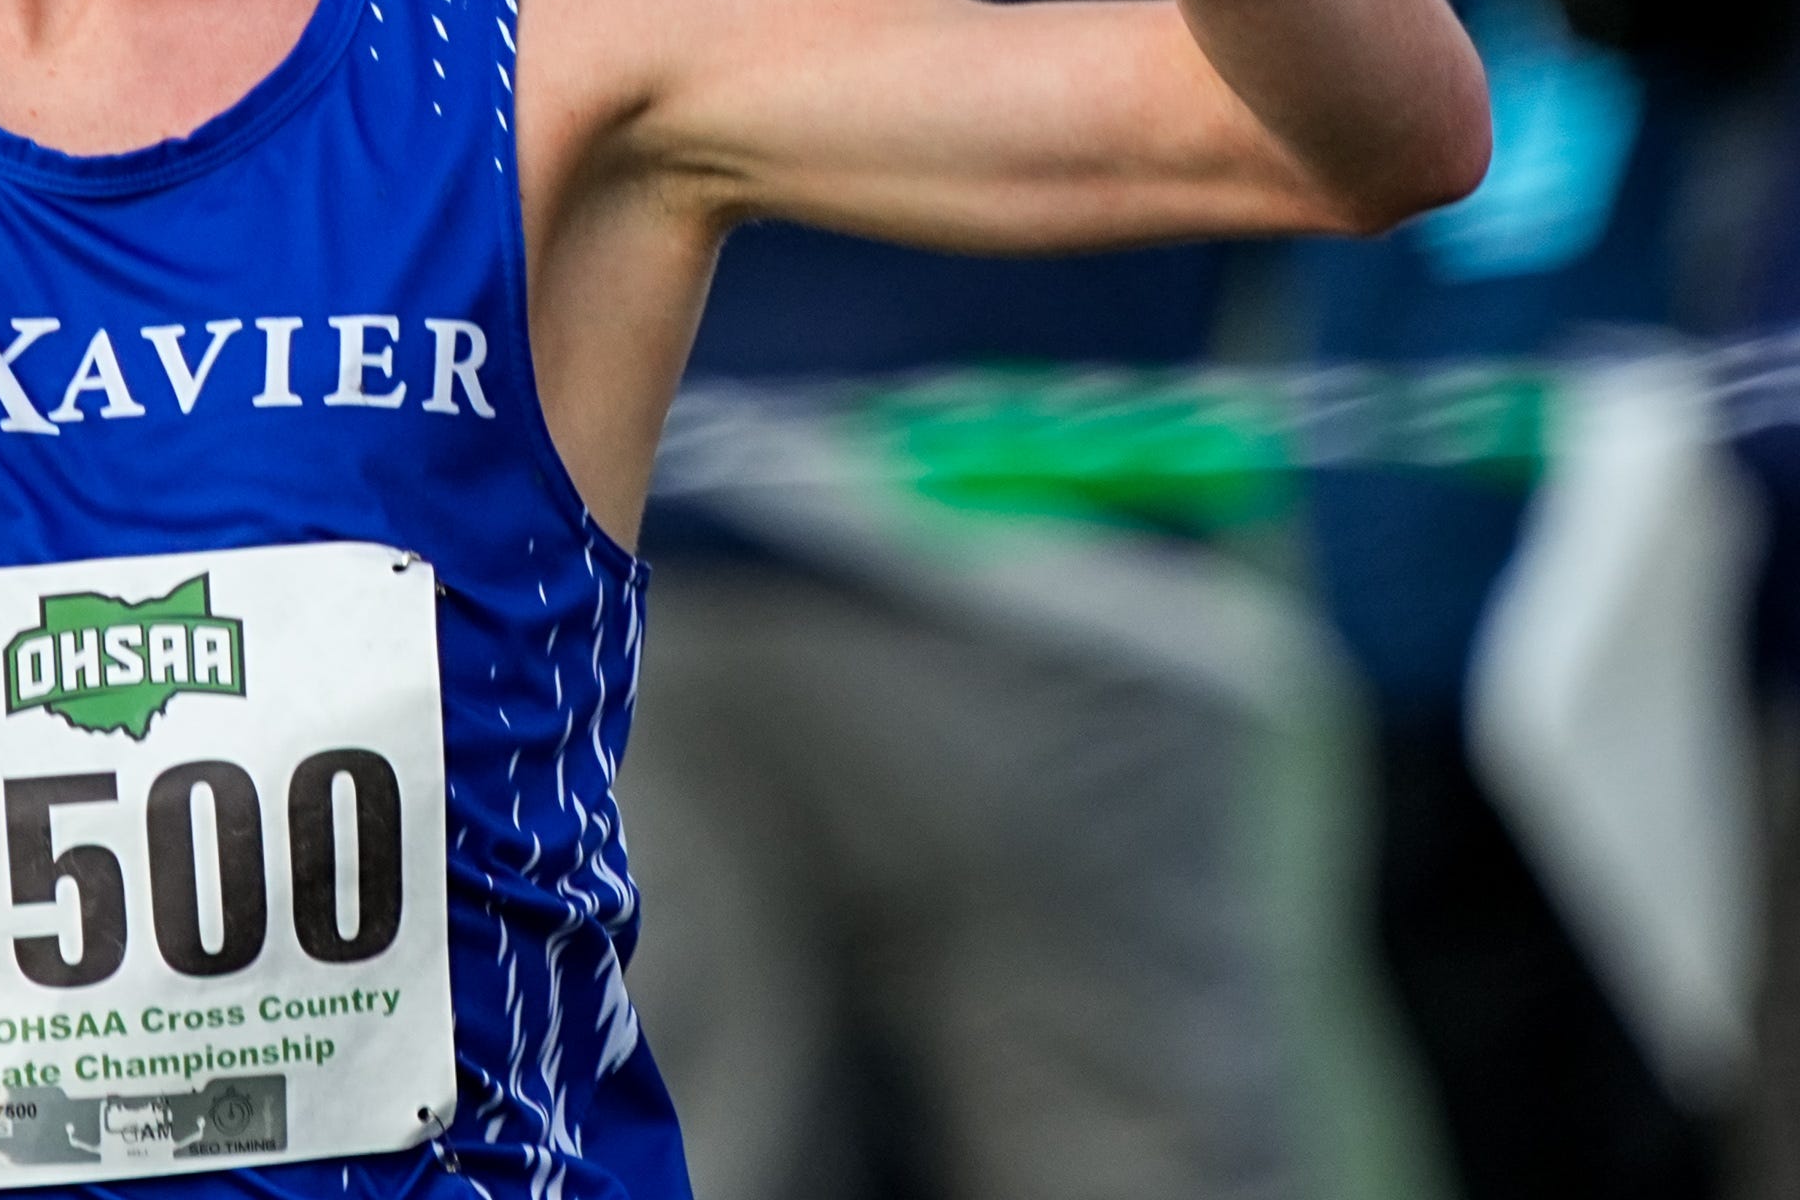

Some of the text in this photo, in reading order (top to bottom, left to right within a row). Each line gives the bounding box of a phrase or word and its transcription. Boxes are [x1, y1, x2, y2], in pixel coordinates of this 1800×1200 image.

[16, 623, 233, 701] OHSAA
[140, 1004, 246, 1034] Cross
[258, 987, 401, 1022] Country
[75, 1033, 335, 1082] Championship
[224, 1137, 277, 1153] TIMING
